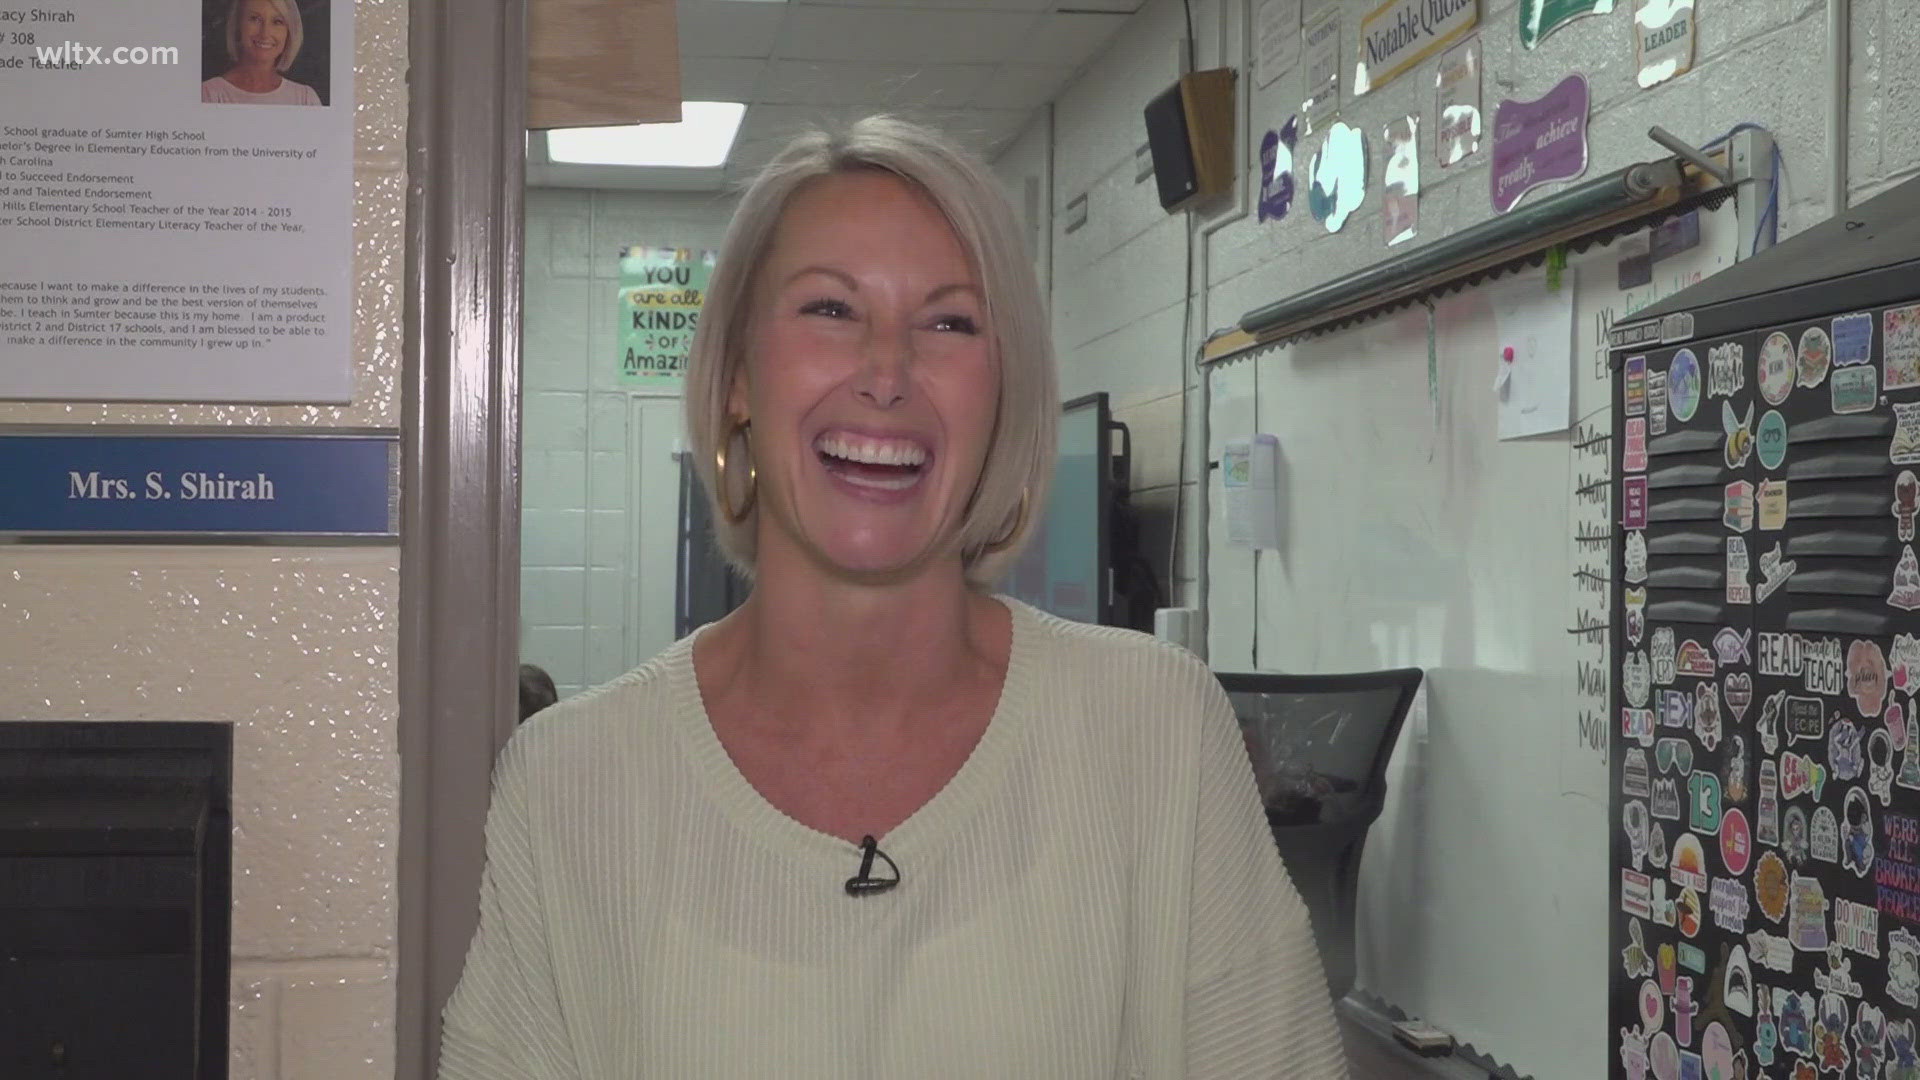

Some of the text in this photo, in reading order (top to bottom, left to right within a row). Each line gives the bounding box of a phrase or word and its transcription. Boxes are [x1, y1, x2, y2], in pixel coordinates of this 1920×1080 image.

[0, 9, 75, 24] acy Shirah
[10, 32, 35, 45] 308
[1366, 6, 1419, 69] Notable
[1644, 19, 1688, 53] LEADER
[3, 126, 206, 141] School graduate of Sumter High School
[1536, 116, 1578, 150] achieve
[9, 156, 53, 166] Carolina
[34, 142, 71, 154] Degree
[74, 143, 84, 152] in
[87, 143, 147, 155] Elementary
[150, 145, 201, 155] Education
[204, 146, 229, 156] from
[232, 147, 249, 156] the
[251, 148, 303, 159] University
[305, 148, 317, 158] of
[5, 171, 135, 183] to Succeed Endorsement
[1498, 157, 1535, 197] greatly.
[12, 186, 152, 198] and Talented Endorsement
[2, 201, 292, 217] Hills Elementary School Teacher of the Year 2014 2015
[16, 216, 50, 226] School
[54, 217, 93, 227] District
[95, 218, 156, 230] Elementary
[158, 220, 201, 232] Literacy
[203, 221, 243, 231] Teacher
[246, 221, 257, 231] of
[260, 221, 278, 231] the
[644, 266, 690, 285] YOU
[0, 282, 38, 290] ecause
[46, 282, 73, 291] want
[76, 282, 88, 292] to
[90, 282, 120, 292] make
[131, 283, 186, 293] difference
[188, 285, 199, 293] in
[202, 284, 220, 294] the
[222, 285, 246, 294] lives
[248, 285, 259, 295] of
[262, 287, 278, 297] my
[26, 295, 38, 304] to
[41, 294, 68, 305] think
[70, 295, 90, 305] and
[93, 297, 120, 307] grow
[122, 296, 142, 306] and
[144, 297, 158, 306] be
[161, 297, 179, 307] the
[181, 297, 204, 307] best
[206, 298, 244, 308] version
[246, 298, 257, 308] of
[260, 299, 318, 309] themselves
[633, 290, 702, 305] are all
[0, 307, 16, 317] be.
[27, 308, 57, 318] teach
[60, 309, 70, 318] in
[73, 308, 112, 319] Sumter
[114, 310, 156, 319] because
[159, 310, 179, 320] this
[182, 312, 190, 320] is
[192, 313, 209, 322] my
[285, 313, 326, 324] product
[0, 322, 32, 331] istrict
[44, 322, 64, 332] and
[67, 322, 106, 332] District
[109, 322, 122, 332] 17
[124, 323, 166, 334] schools,
[169, 324, 189, 334] and
[198, 326, 214, 334] am
[217, 324, 256, 334] blessed
[258, 326, 270, 335] to
[272, 325, 286, 335] be
[288, 325, 311, 336] able
[313, 327, 325, 336] to
[6, 334, 36, 344] make
[47, 335, 103, 346] difference
[118, 337, 137, 346] the
[139, 338, 197, 348] community
[206, 340, 233, 349] grew
[234, 340, 249, 350] up
[1578, 423, 1609, 475] May
[68, 471, 275, 500] Mrs. S. Shirah
[1578, 473, 1607, 519] May
[1578, 520, 1610, 565] May
[1578, 562, 1605, 609] May
[1577, 607, 1604, 664] May
[1759, 634, 1802, 674] READ
[1577, 659, 1606, 712] May
[1803, 657, 1842, 692] TEACH
[1623, 710, 1654, 736] READ
[1578, 709, 1608, 766] May
[1689, 771, 1721, 834] 13
[1836, 899, 1878, 931] DO WHAT
[1835, 924, 1855, 948] YOU
